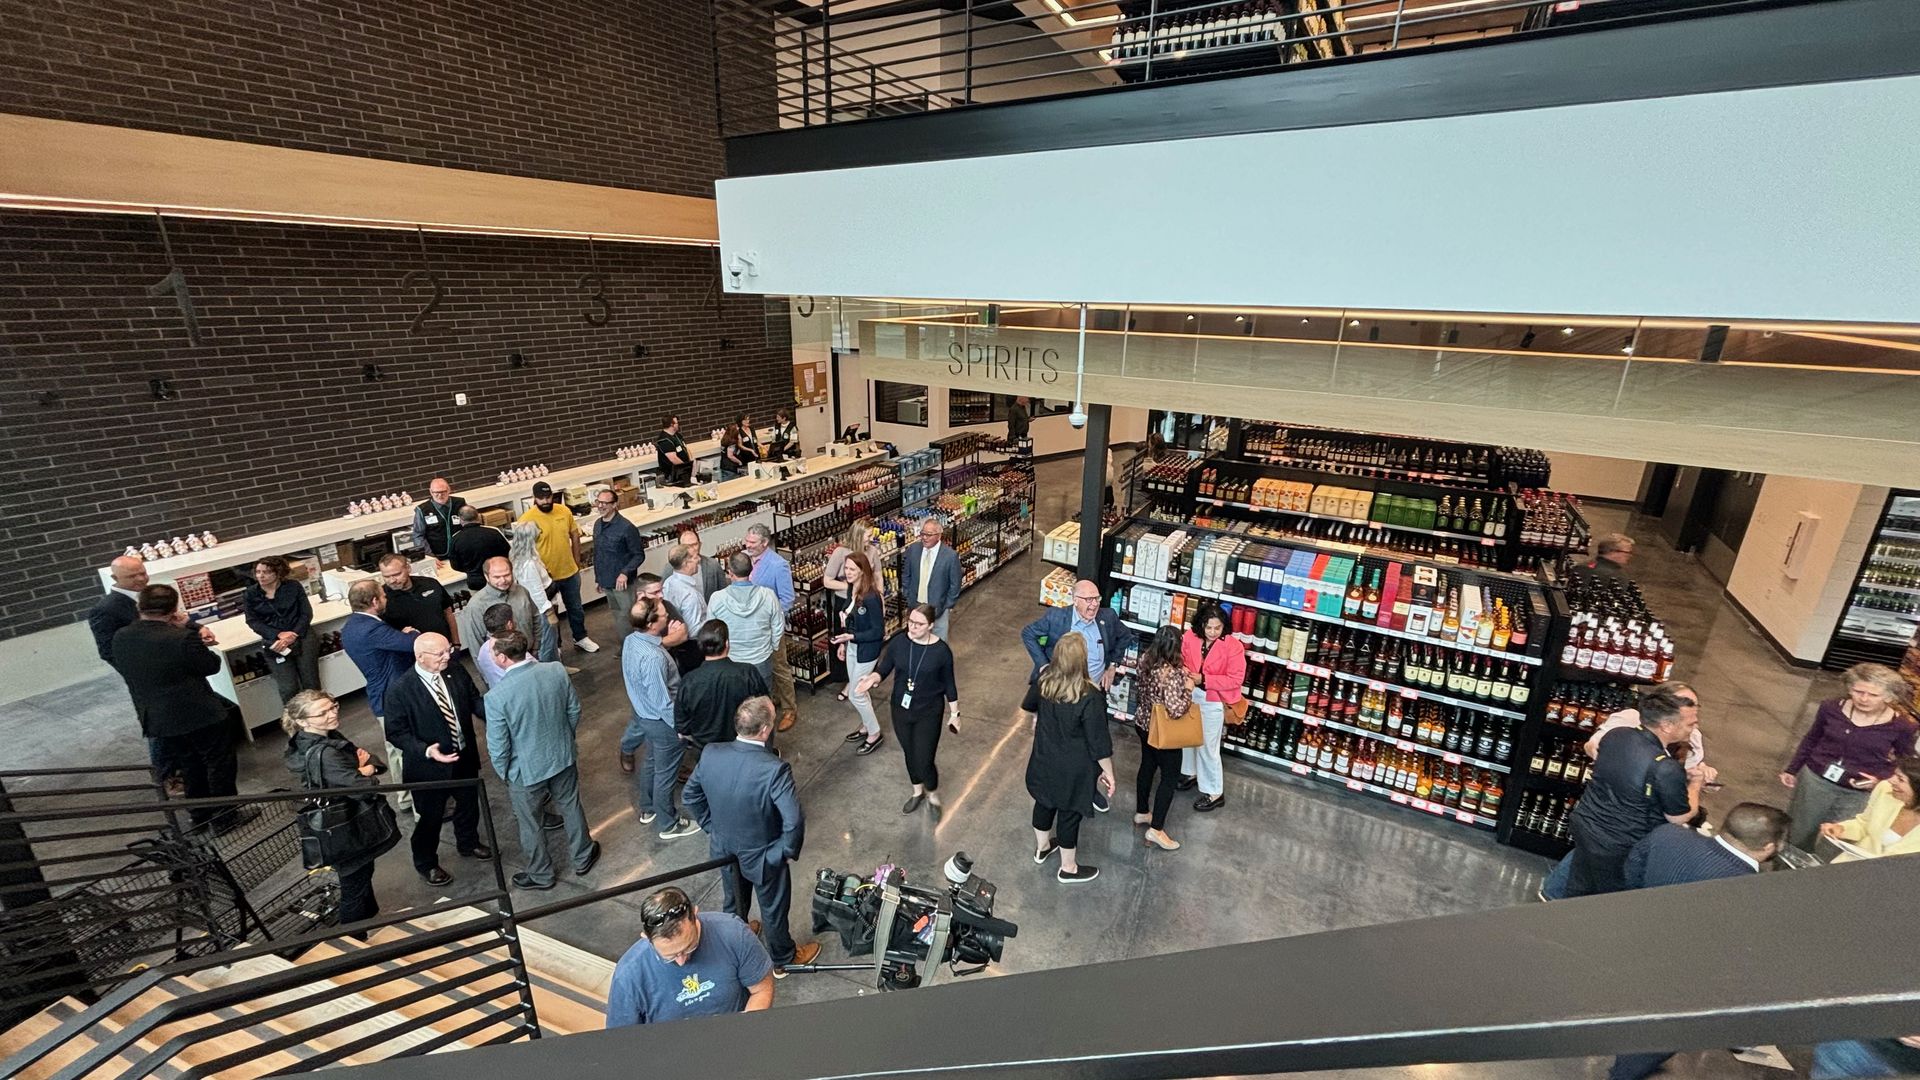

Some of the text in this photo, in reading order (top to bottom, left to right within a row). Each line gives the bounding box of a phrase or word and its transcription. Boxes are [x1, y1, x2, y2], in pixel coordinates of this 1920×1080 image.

[147, 267, 202, 347] 1
[402, 270, 452, 335] 2
[577, 272, 612, 327] 3
[948, 342, 1059, 384] SPIRITS
